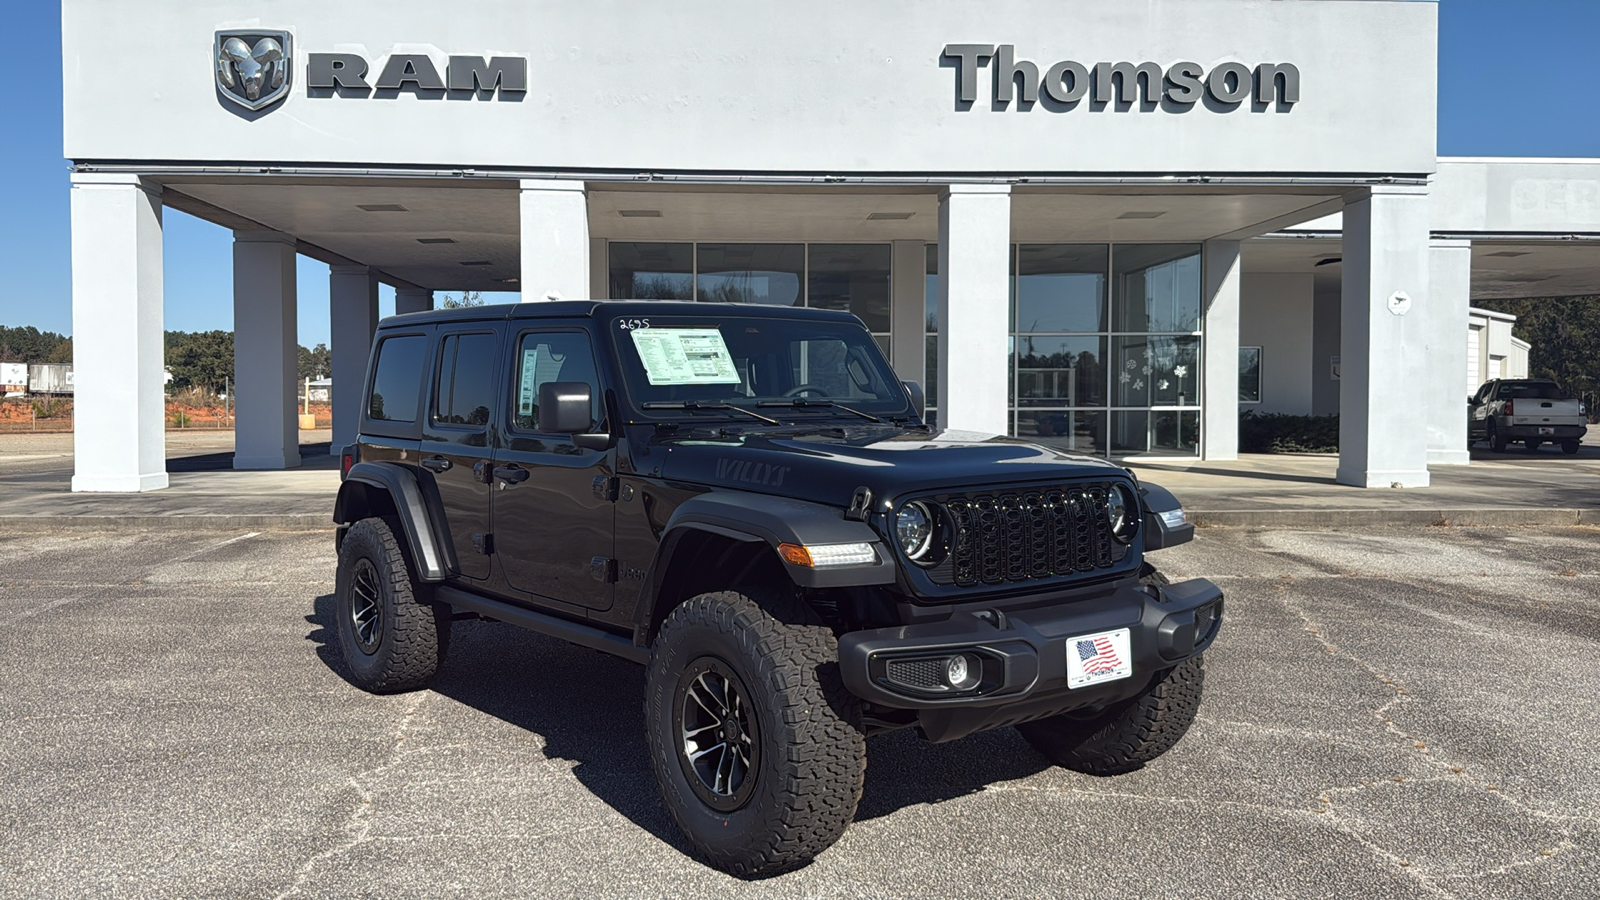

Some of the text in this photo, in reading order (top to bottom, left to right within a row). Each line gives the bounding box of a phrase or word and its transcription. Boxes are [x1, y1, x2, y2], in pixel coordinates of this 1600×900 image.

[306, 53, 527, 97] RAM
[940, 44, 1300, 108] Thomson
[715, 458, 792, 487] WILLYS
